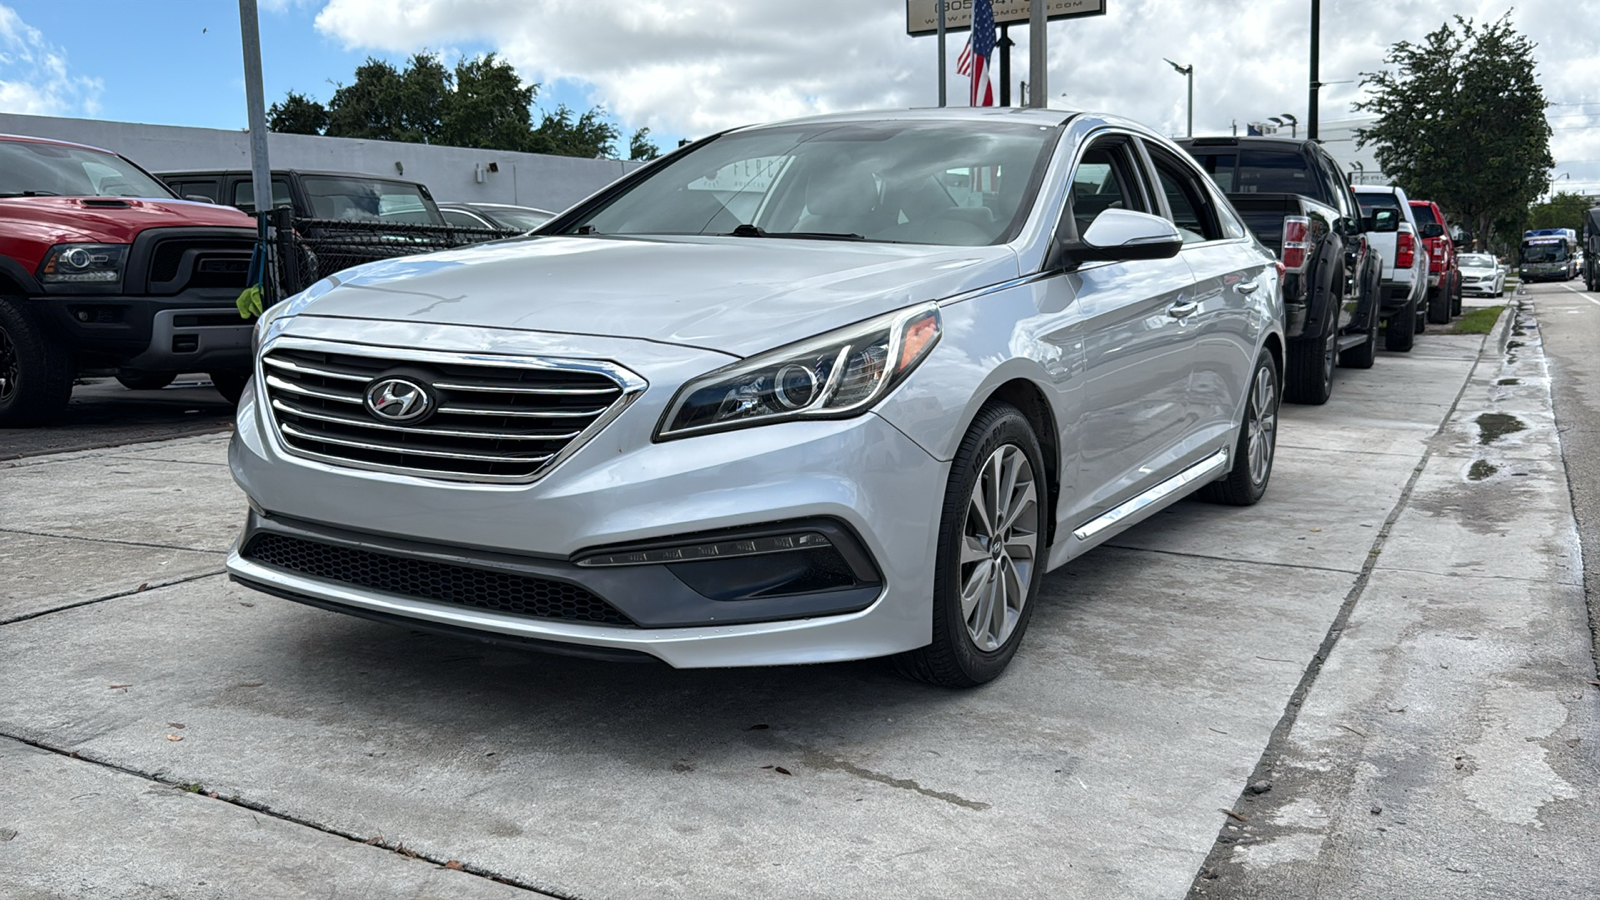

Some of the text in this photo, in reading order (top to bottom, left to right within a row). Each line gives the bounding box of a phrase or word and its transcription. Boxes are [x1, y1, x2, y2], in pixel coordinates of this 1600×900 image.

[924, 1, 1083, 24] WW.FOMOT.COM
[972, 420, 1008, 474] IOTA EVT
